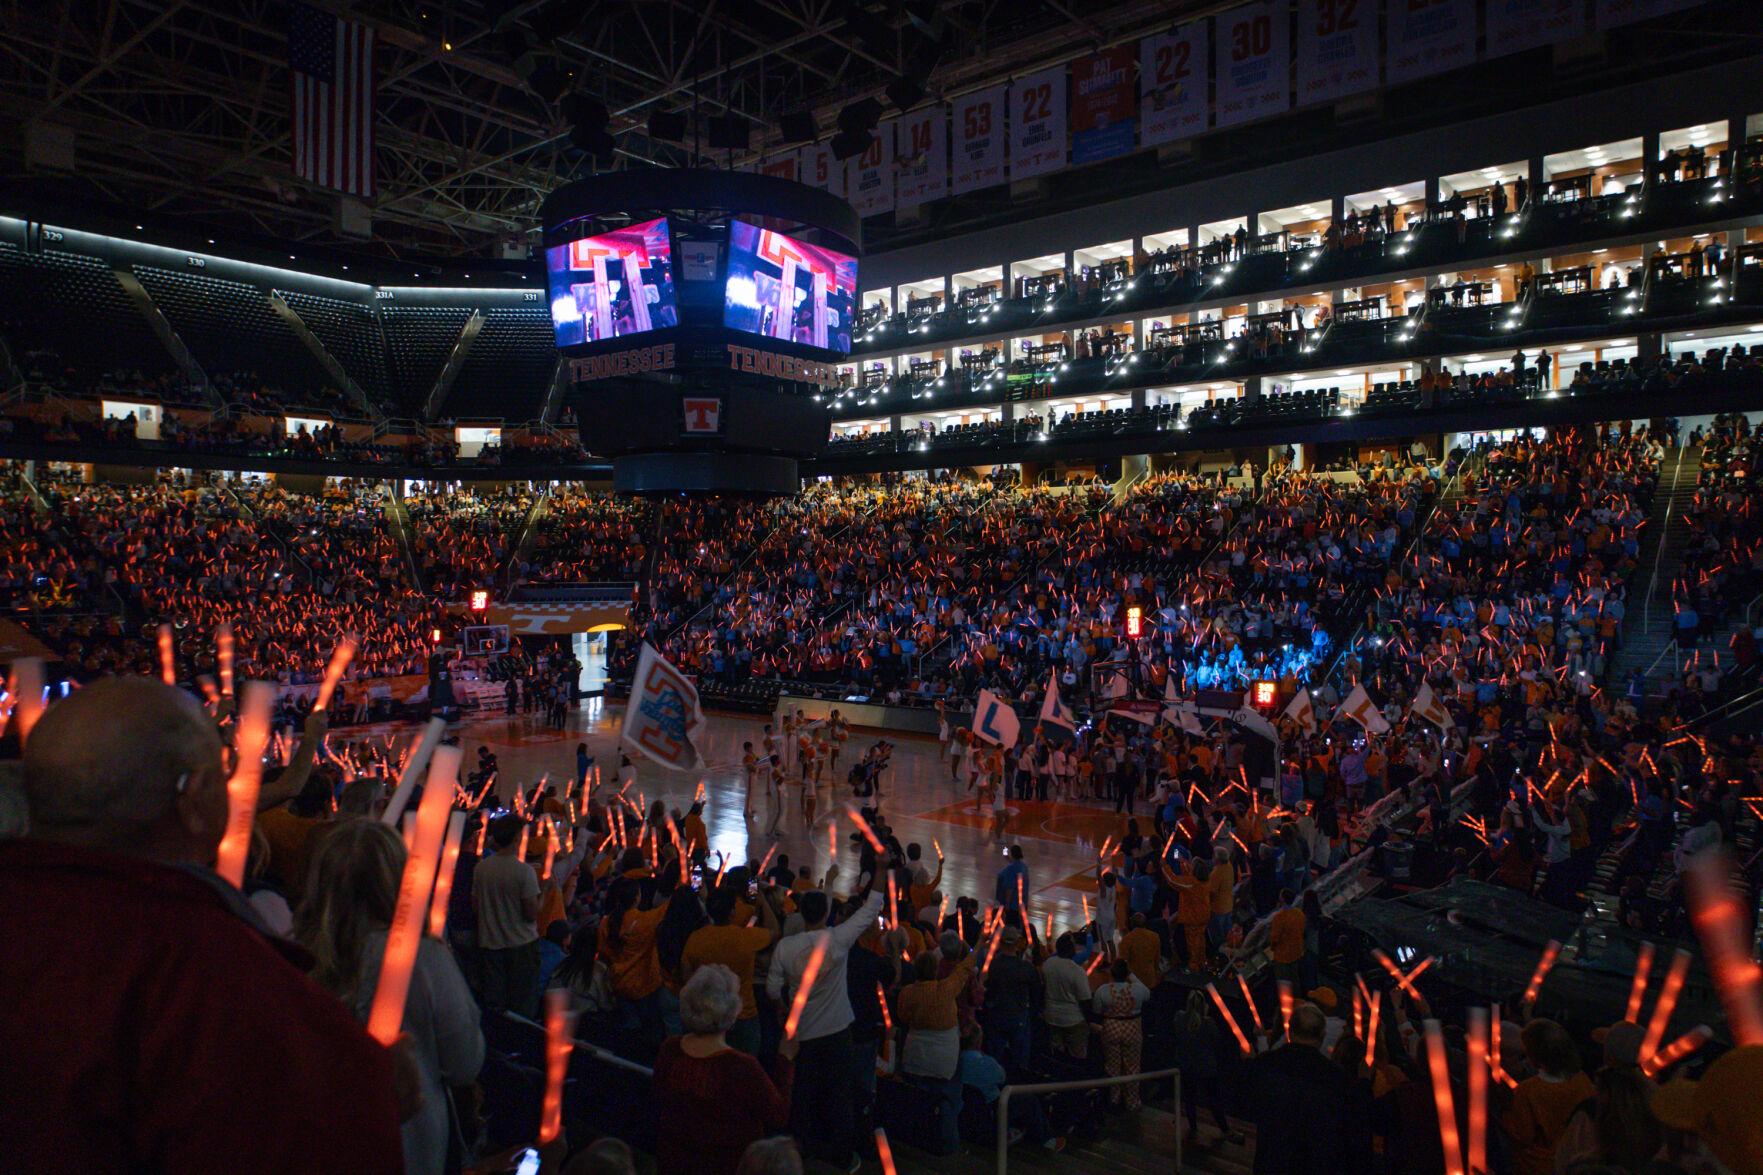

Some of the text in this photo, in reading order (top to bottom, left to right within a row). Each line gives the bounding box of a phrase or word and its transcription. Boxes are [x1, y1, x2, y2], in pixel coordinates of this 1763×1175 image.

[1232, 15, 1271, 62] 30
[1157, 41, 1191, 85] 22
[1023, 83, 1052, 124] 22
[911, 120, 932, 154] 14
[964, 102, 992, 140] 53
[816, 153, 828, 182] 5
[43, 230, 63, 242] 329
[188, 256, 205, 268] 330
[375, 291, 394, 299] 331A
[524, 293, 537, 301] 331
[569, 343, 676, 384] TENNESSEE
[727, 344, 839, 389] TENNESSEE
[685, 401, 717, 429] T
[511, 615, 572, 634] T
[982, 701, 1001, 741] L
